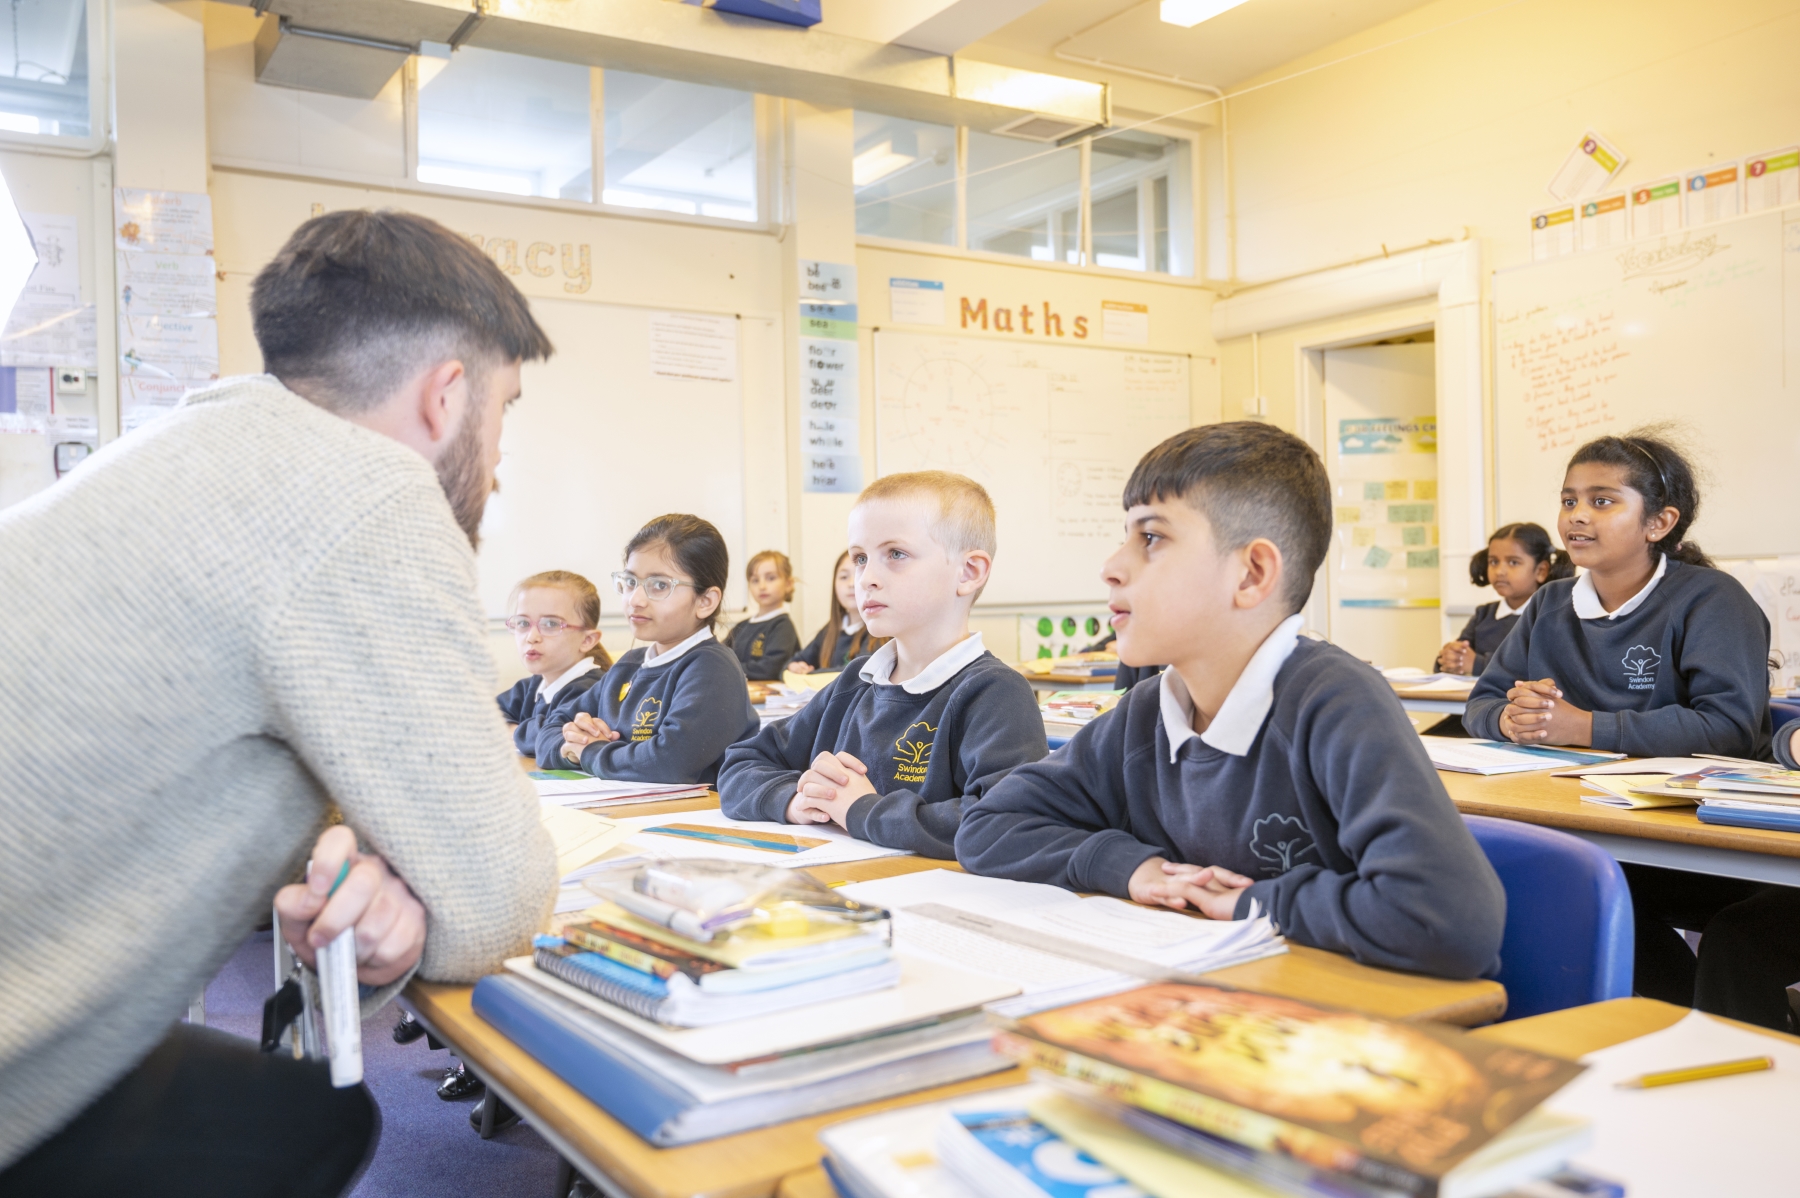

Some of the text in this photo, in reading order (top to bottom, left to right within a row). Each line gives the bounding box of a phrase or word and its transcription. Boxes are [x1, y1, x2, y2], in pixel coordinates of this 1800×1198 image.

[150, 195, 182, 206] dverb
[155, 260, 180, 271] Verb
[960, 297, 1088, 339] Maths
[146, 320, 194, 332] Aective
[808, 346, 837, 356] flor
[138, 381, 203, 394] Conjunct
[809, 420, 835, 431] hle
[1422, 423, 1437, 433] CH
[809, 437, 844, 448] whle
